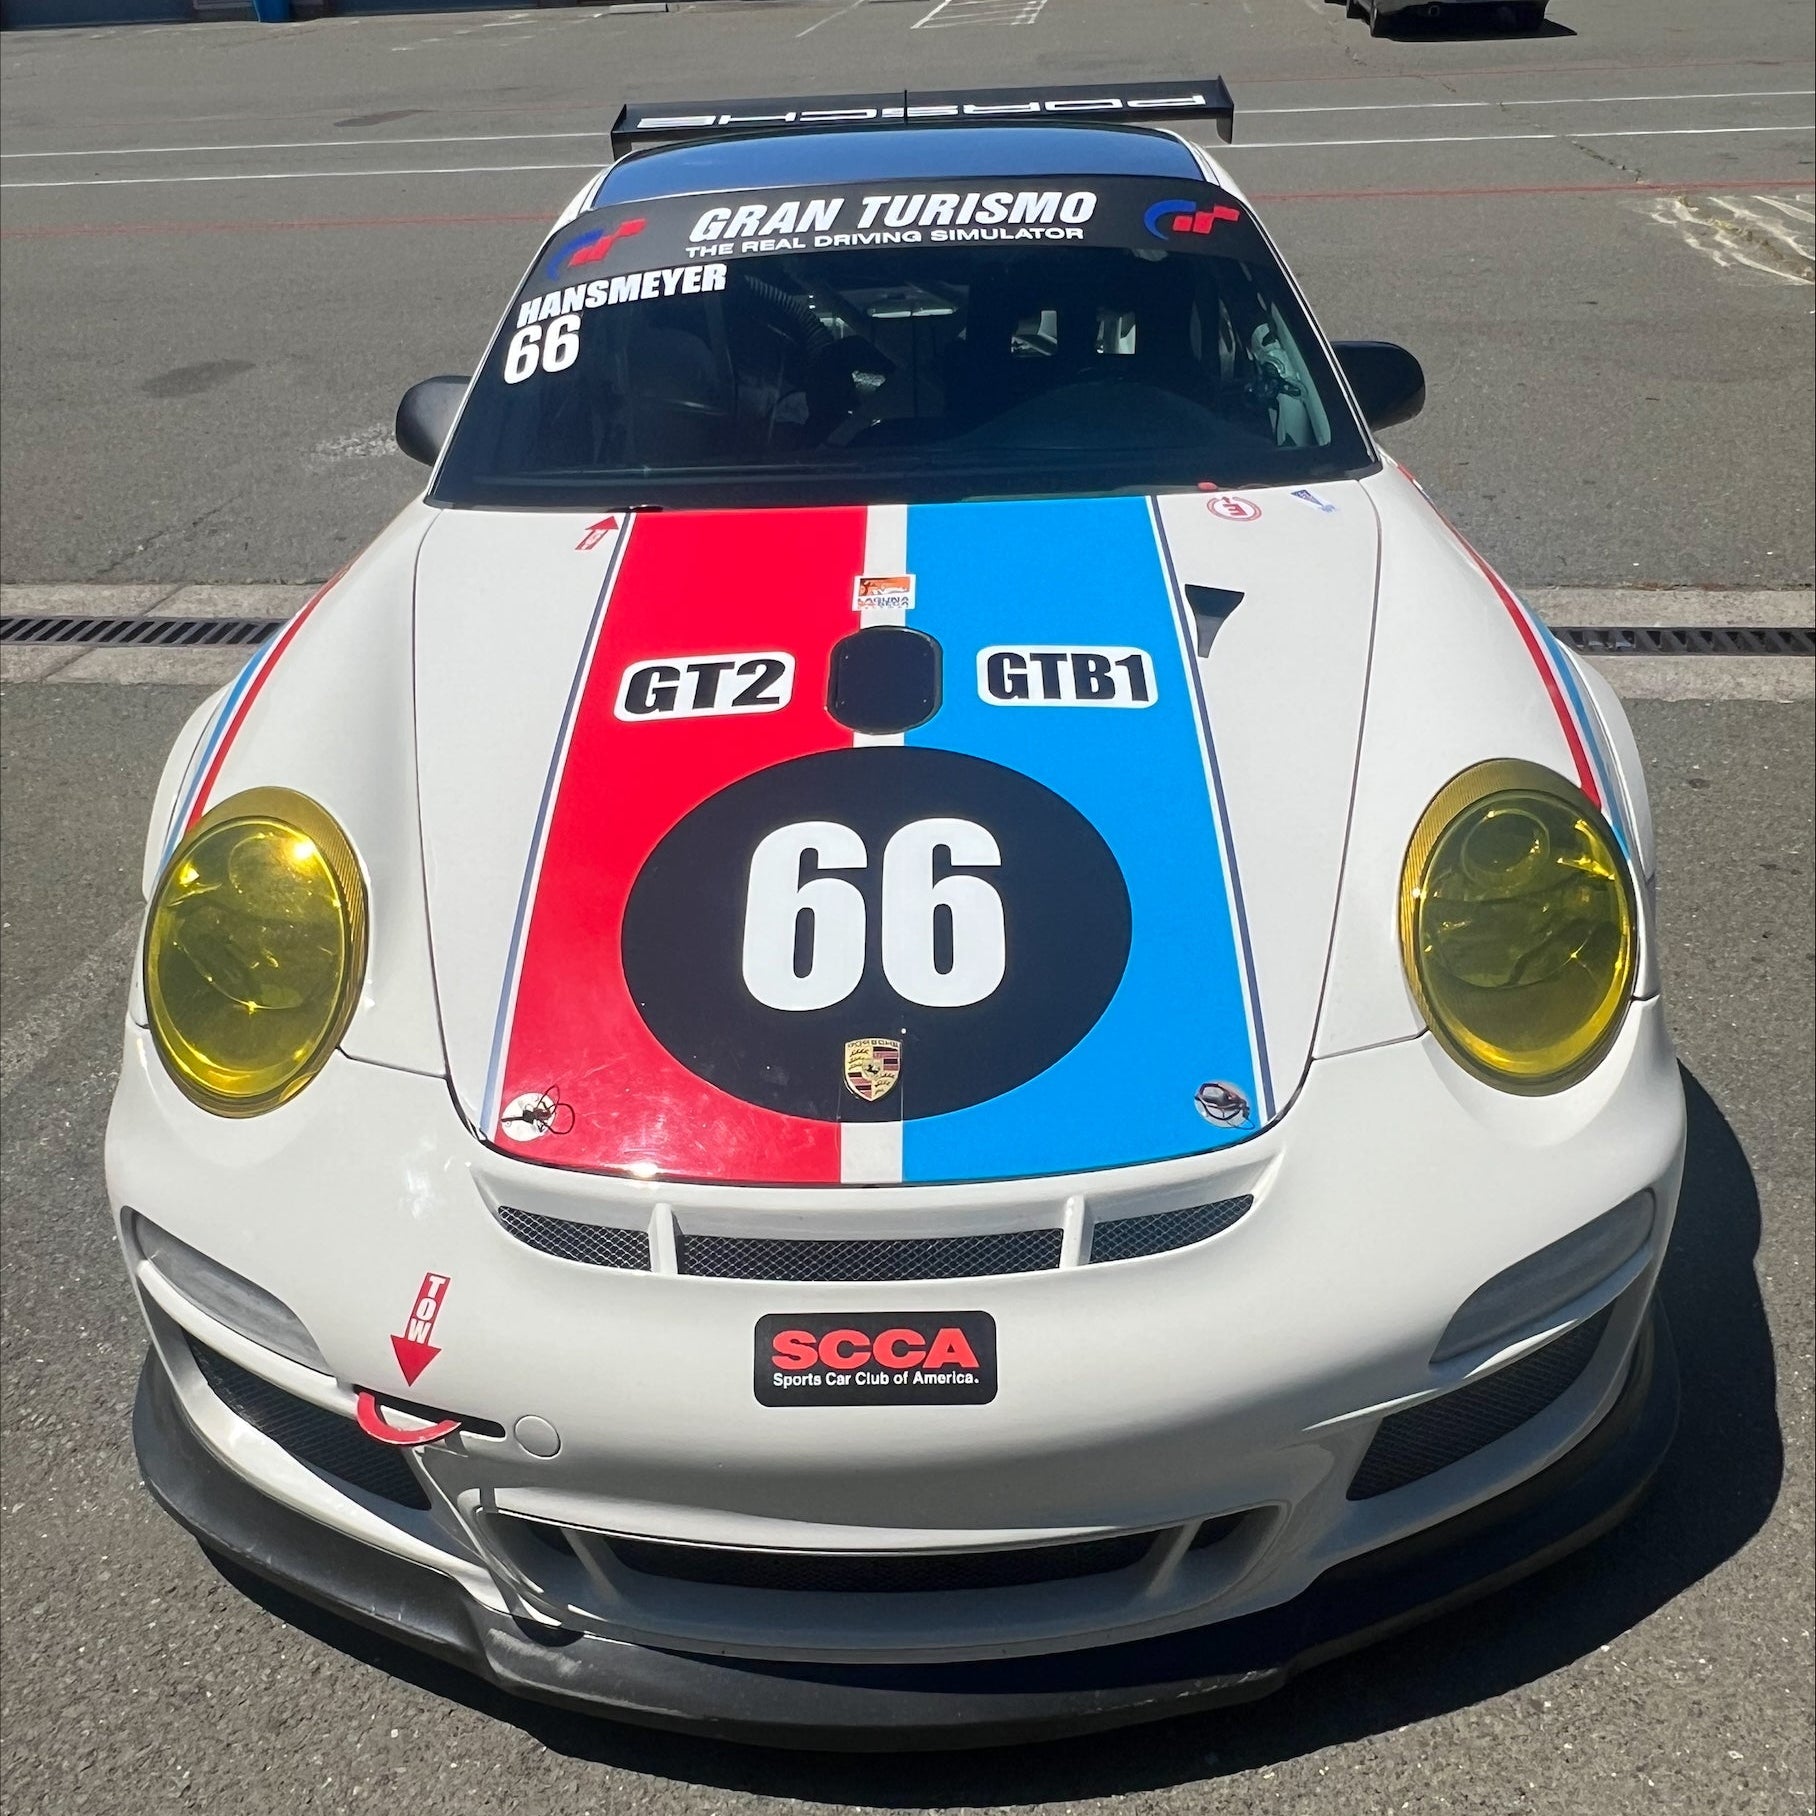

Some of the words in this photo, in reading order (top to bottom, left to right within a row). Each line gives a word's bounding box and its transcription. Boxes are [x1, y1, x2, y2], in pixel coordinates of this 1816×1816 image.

[637, 95, 1206, 128] PORSCHE
[685, 243, 734, 258] THE
[741, 237, 806, 253] REAL
[814, 230, 922, 248] DRIVING
[931, 227, 1085, 242] SIMULATOR
[689, 198, 845, 243] GRAN
[857, 191, 1097, 229] TURISMO
[516, 263, 728, 329] HANSMEYER
[504, 314, 582, 385] 66
[623, 658, 787, 716] GT2
[986, 652, 1151, 703] GTB1
[742, 817, 1006, 1012] 66
[407, 1275, 446, 1345] TOW
[771, 1327, 981, 1370] SCCA
[773, 1371, 822, 1388] Sports
[825, 1371, 852, 1386] Car
[855, 1370, 890, 1385] Club
[892, 1370, 909, 1385] of
[912, 1370, 980, 1385] America.
